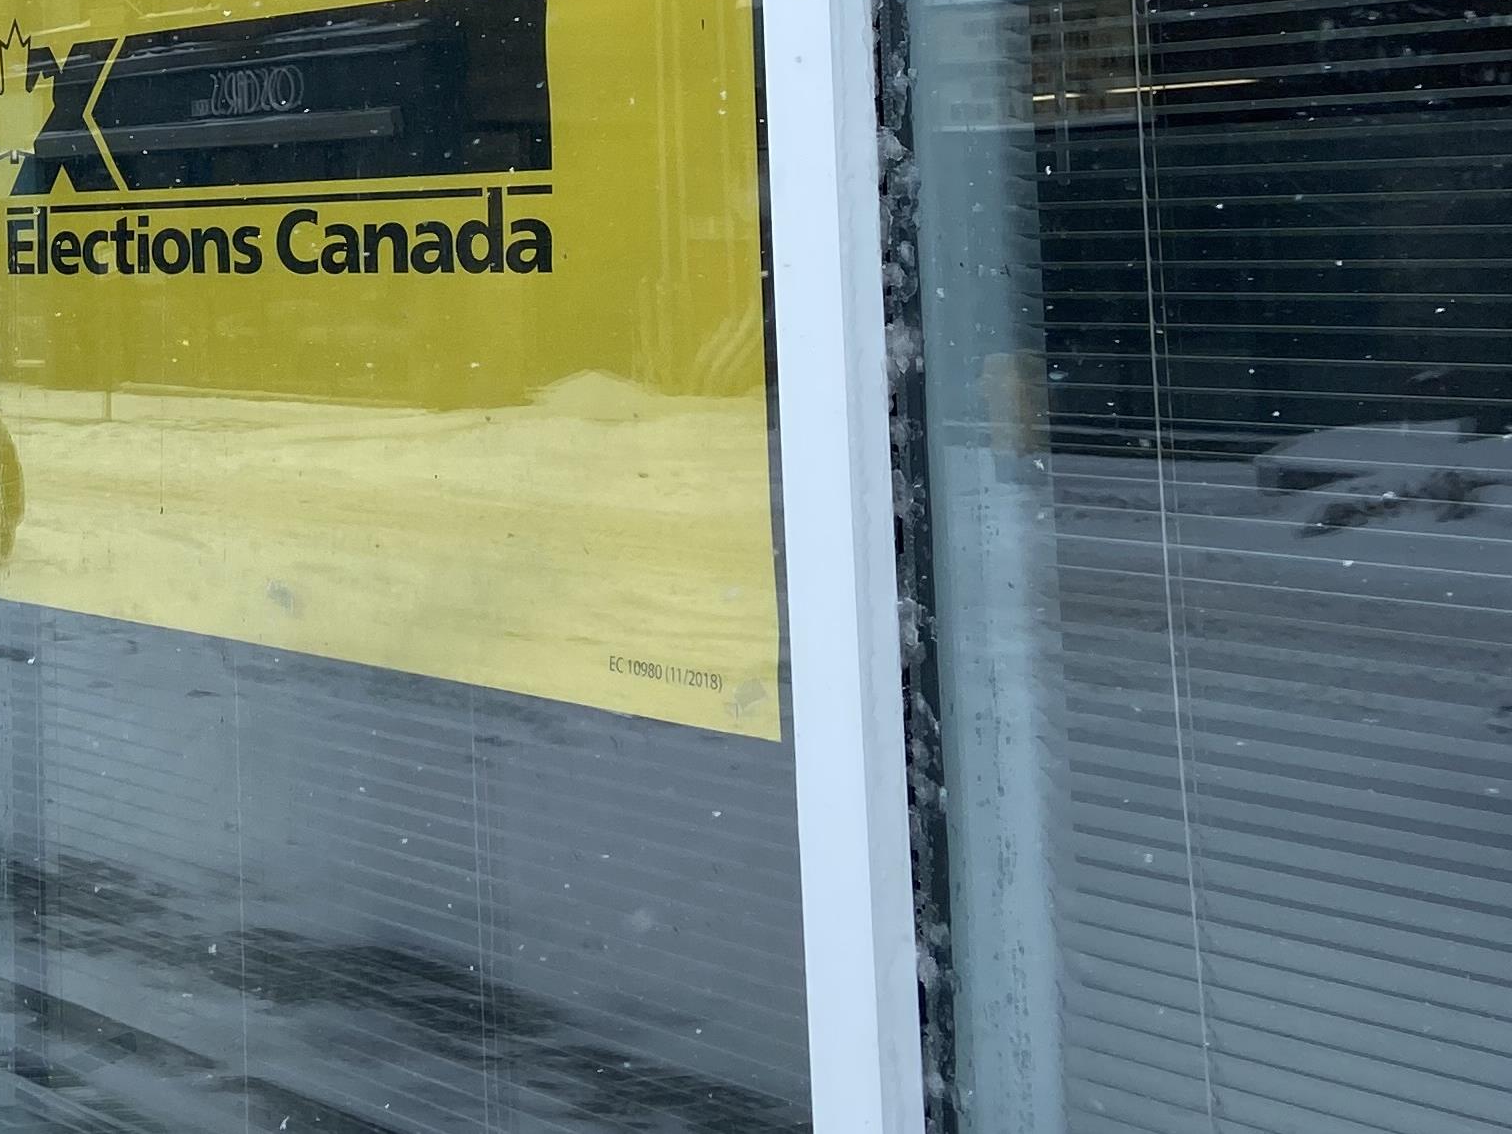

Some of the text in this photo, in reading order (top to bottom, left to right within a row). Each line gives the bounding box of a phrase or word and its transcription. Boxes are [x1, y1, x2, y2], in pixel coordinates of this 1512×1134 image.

[7, 186, 553, 275] Elections Canada
[609, 655, 723, 693] EC 10980 (11/2018)
